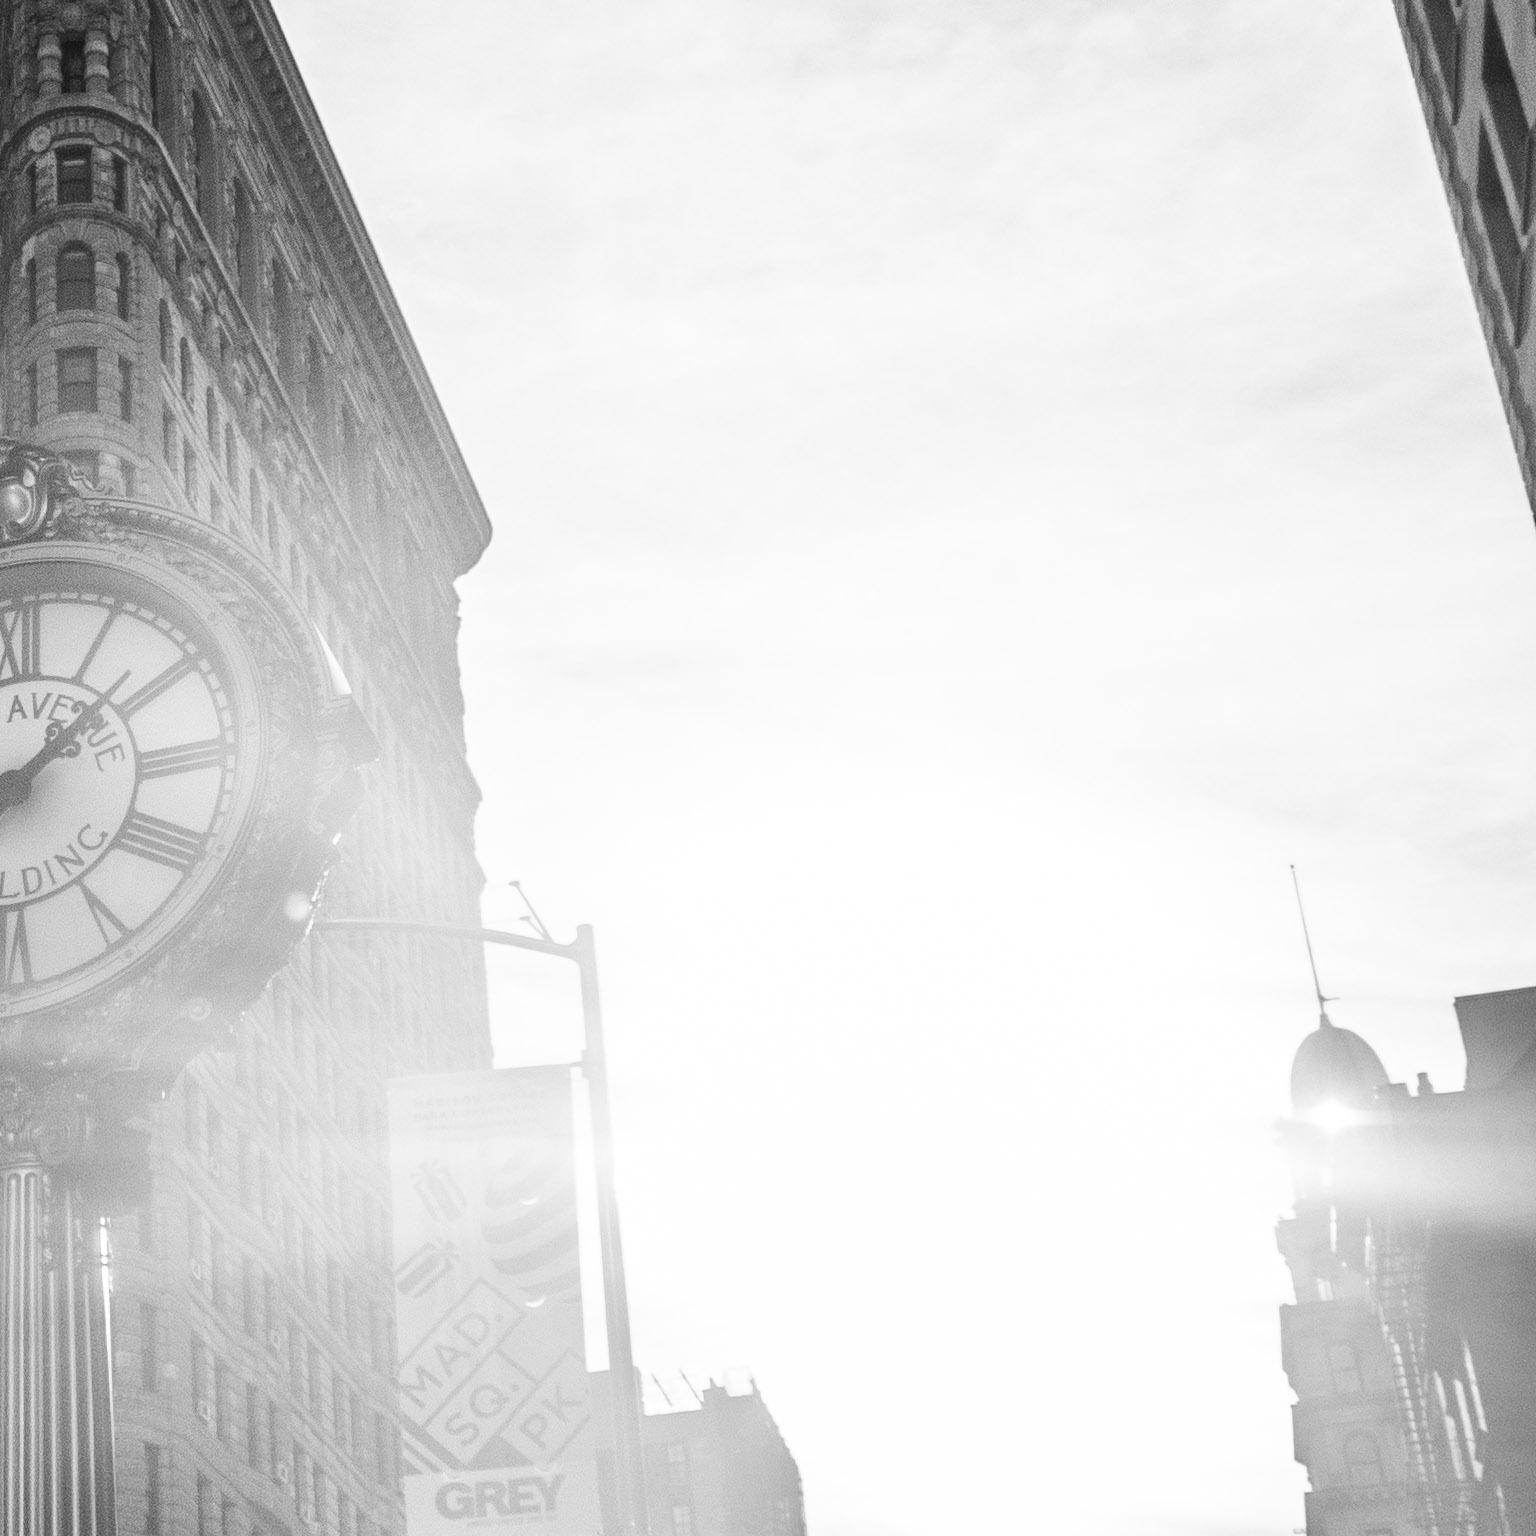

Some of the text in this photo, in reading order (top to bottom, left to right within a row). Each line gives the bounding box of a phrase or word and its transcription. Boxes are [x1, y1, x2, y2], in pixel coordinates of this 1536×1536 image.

[6, 692, 125, 772] AVEUE
[399, 1312, 503, 1410] MAD.
[443, 1383, 520, 1447] SQ.
[435, 1473, 566, 1520] GREY
